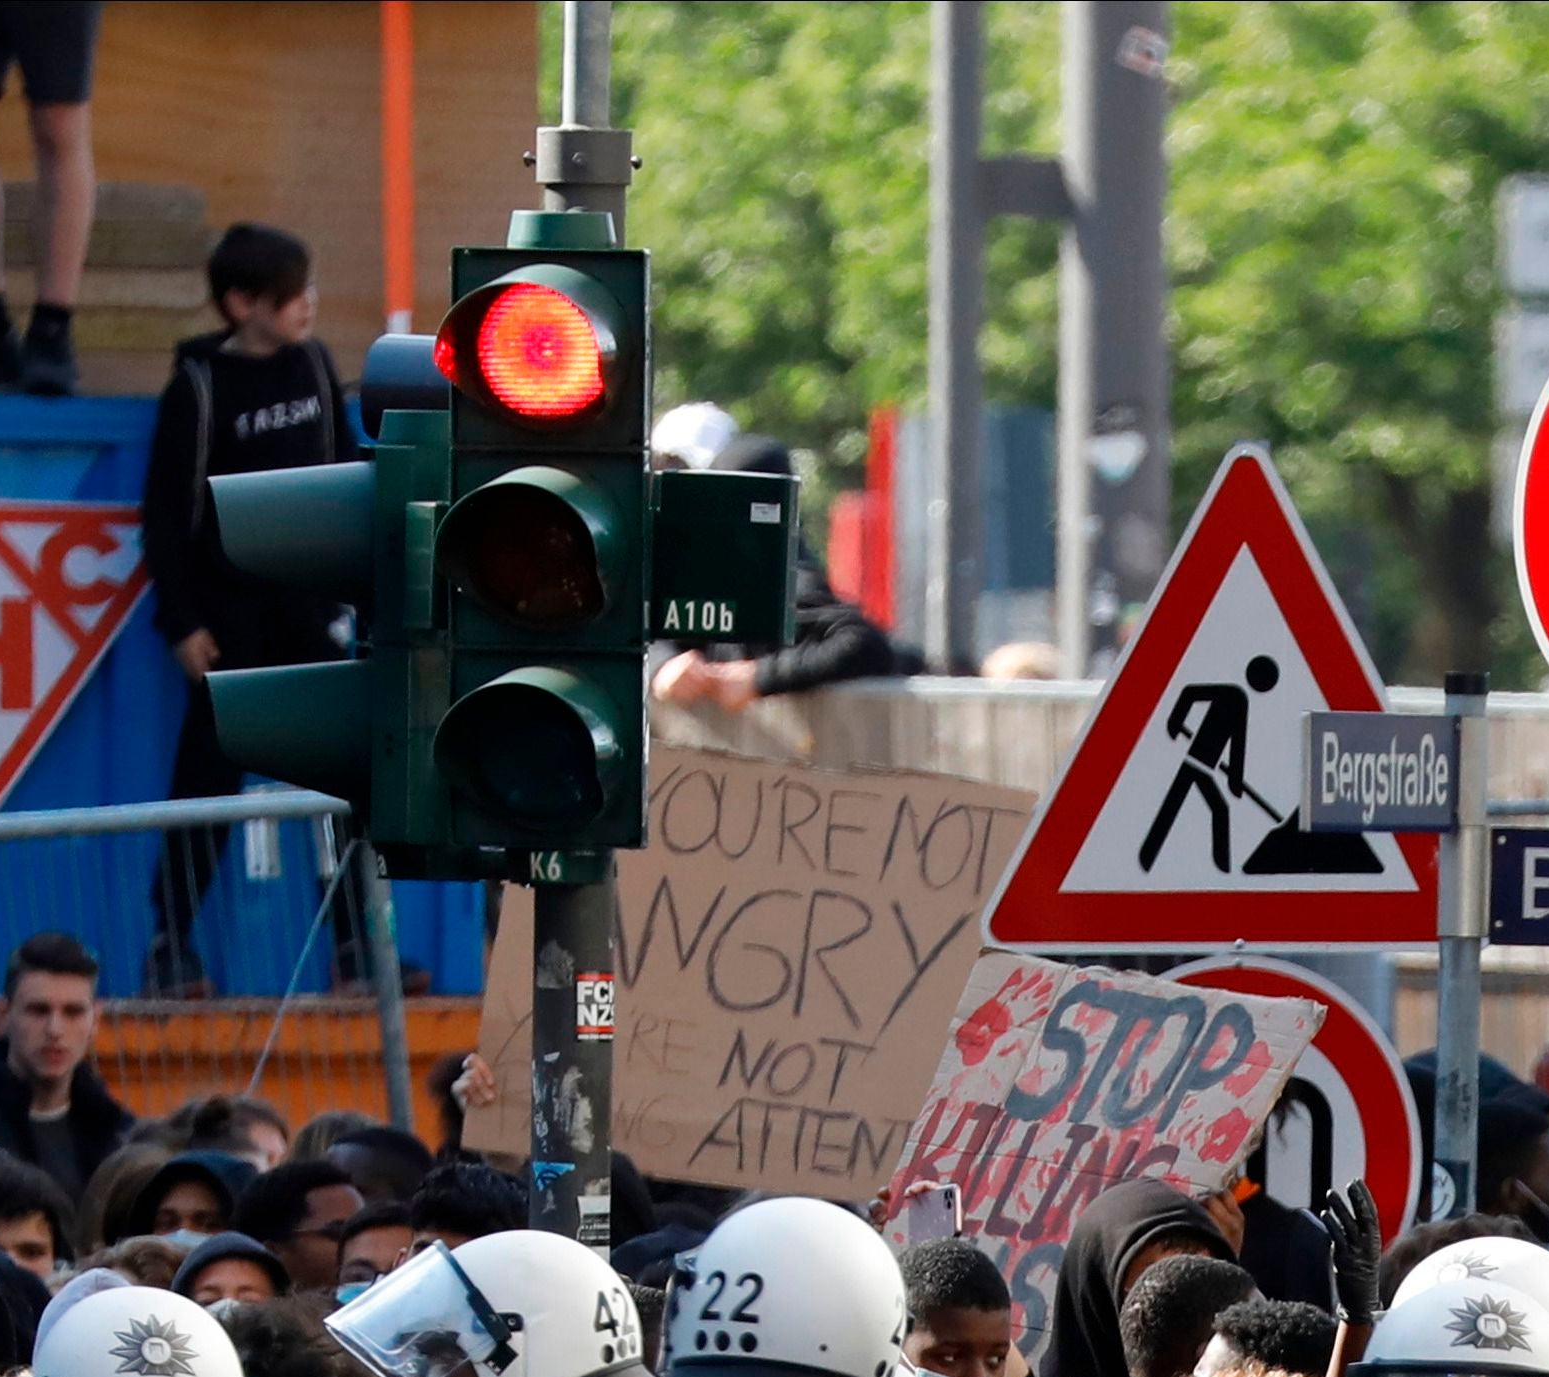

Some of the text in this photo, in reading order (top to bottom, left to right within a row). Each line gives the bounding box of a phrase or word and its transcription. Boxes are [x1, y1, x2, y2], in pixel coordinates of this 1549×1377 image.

[663, 600, 734, 633] A10b
[1321, 731, 1448, 824] Bergstraße
[530, 852, 562, 880] K6
[879, 794, 1028, 896] NOT
[577, 981, 615, 1003] FC
[718, 1029, 877, 1103] NOT
[1005, 980, 1256, 1132] STOP
[594, 1286, 636, 1338] 42
[699, 1270, 765, 1324] 22
